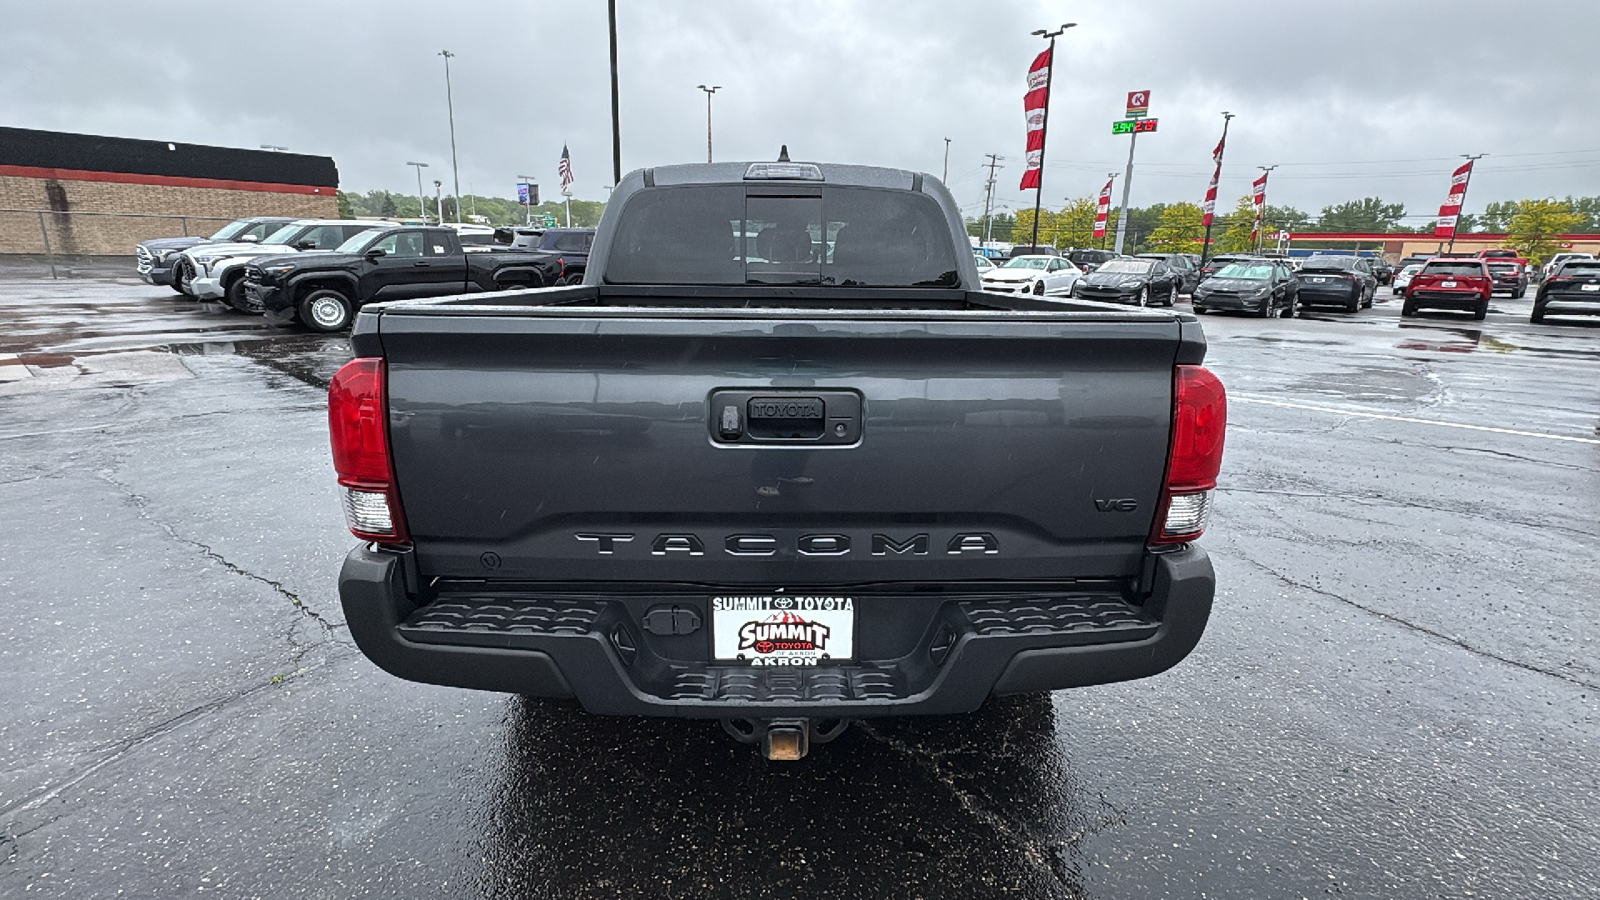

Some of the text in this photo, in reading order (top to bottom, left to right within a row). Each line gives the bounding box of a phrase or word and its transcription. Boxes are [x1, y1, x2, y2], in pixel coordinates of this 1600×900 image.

[754, 402, 819, 417] TOYOTA
[1094, 498, 1137, 512] V6
[574, 532, 999, 556] TACOMA
[713, 597, 853, 611] SUMMIT TOYOTA
[738, 621, 830, 650] SUMMIT
[751, 657, 818, 666] AKRON
